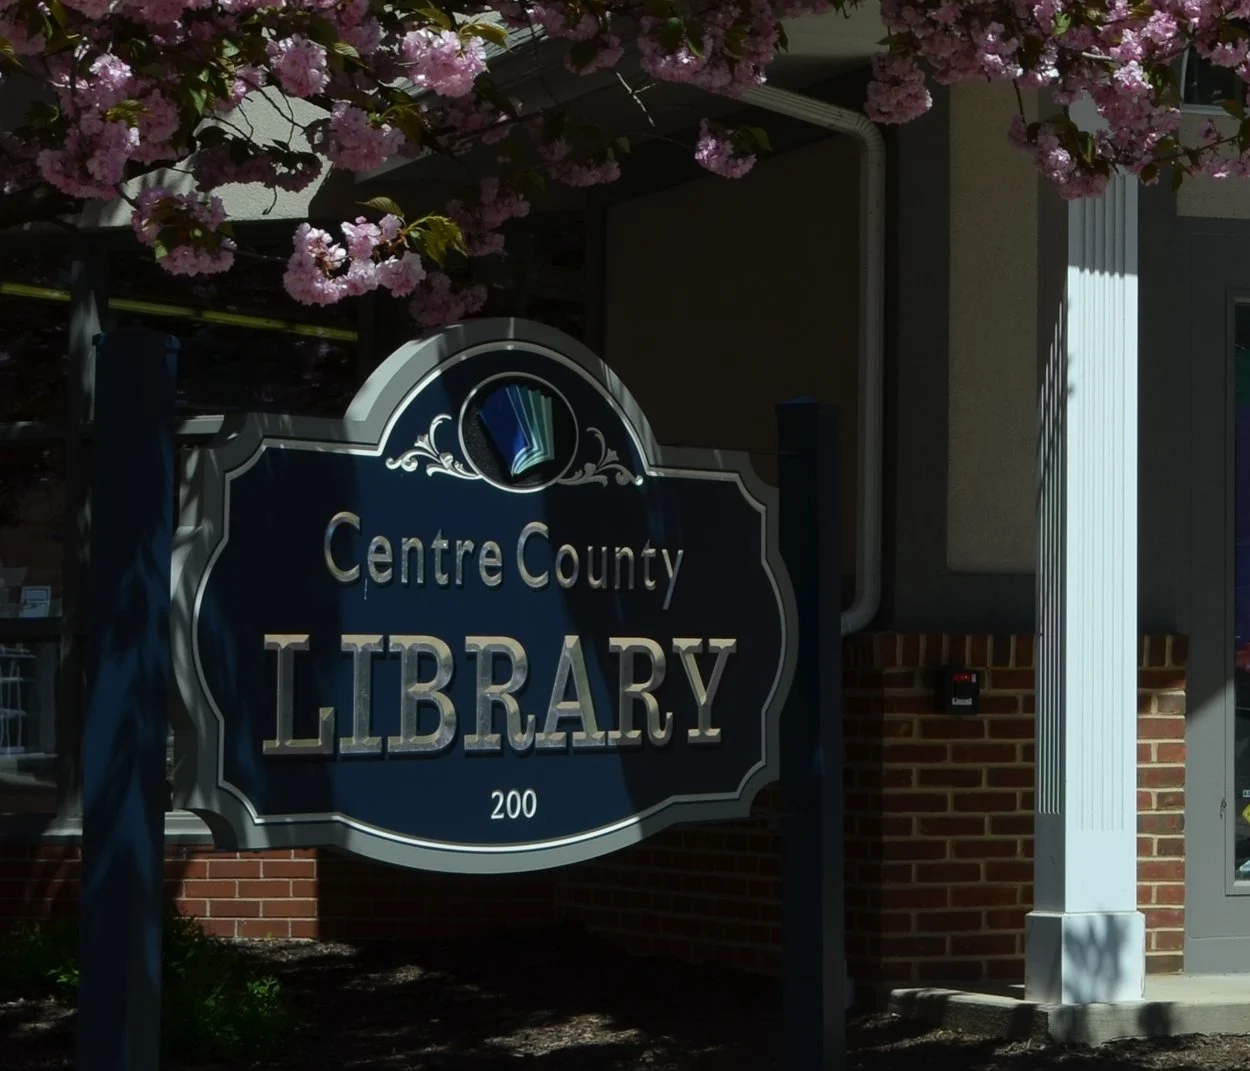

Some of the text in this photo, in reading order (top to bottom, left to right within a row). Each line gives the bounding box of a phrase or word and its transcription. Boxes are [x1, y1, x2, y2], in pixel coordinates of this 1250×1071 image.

[323, 511, 685, 611] Centre County
[262, 634, 737, 756] LIBRARY
[490, 789, 538, 820] 200
